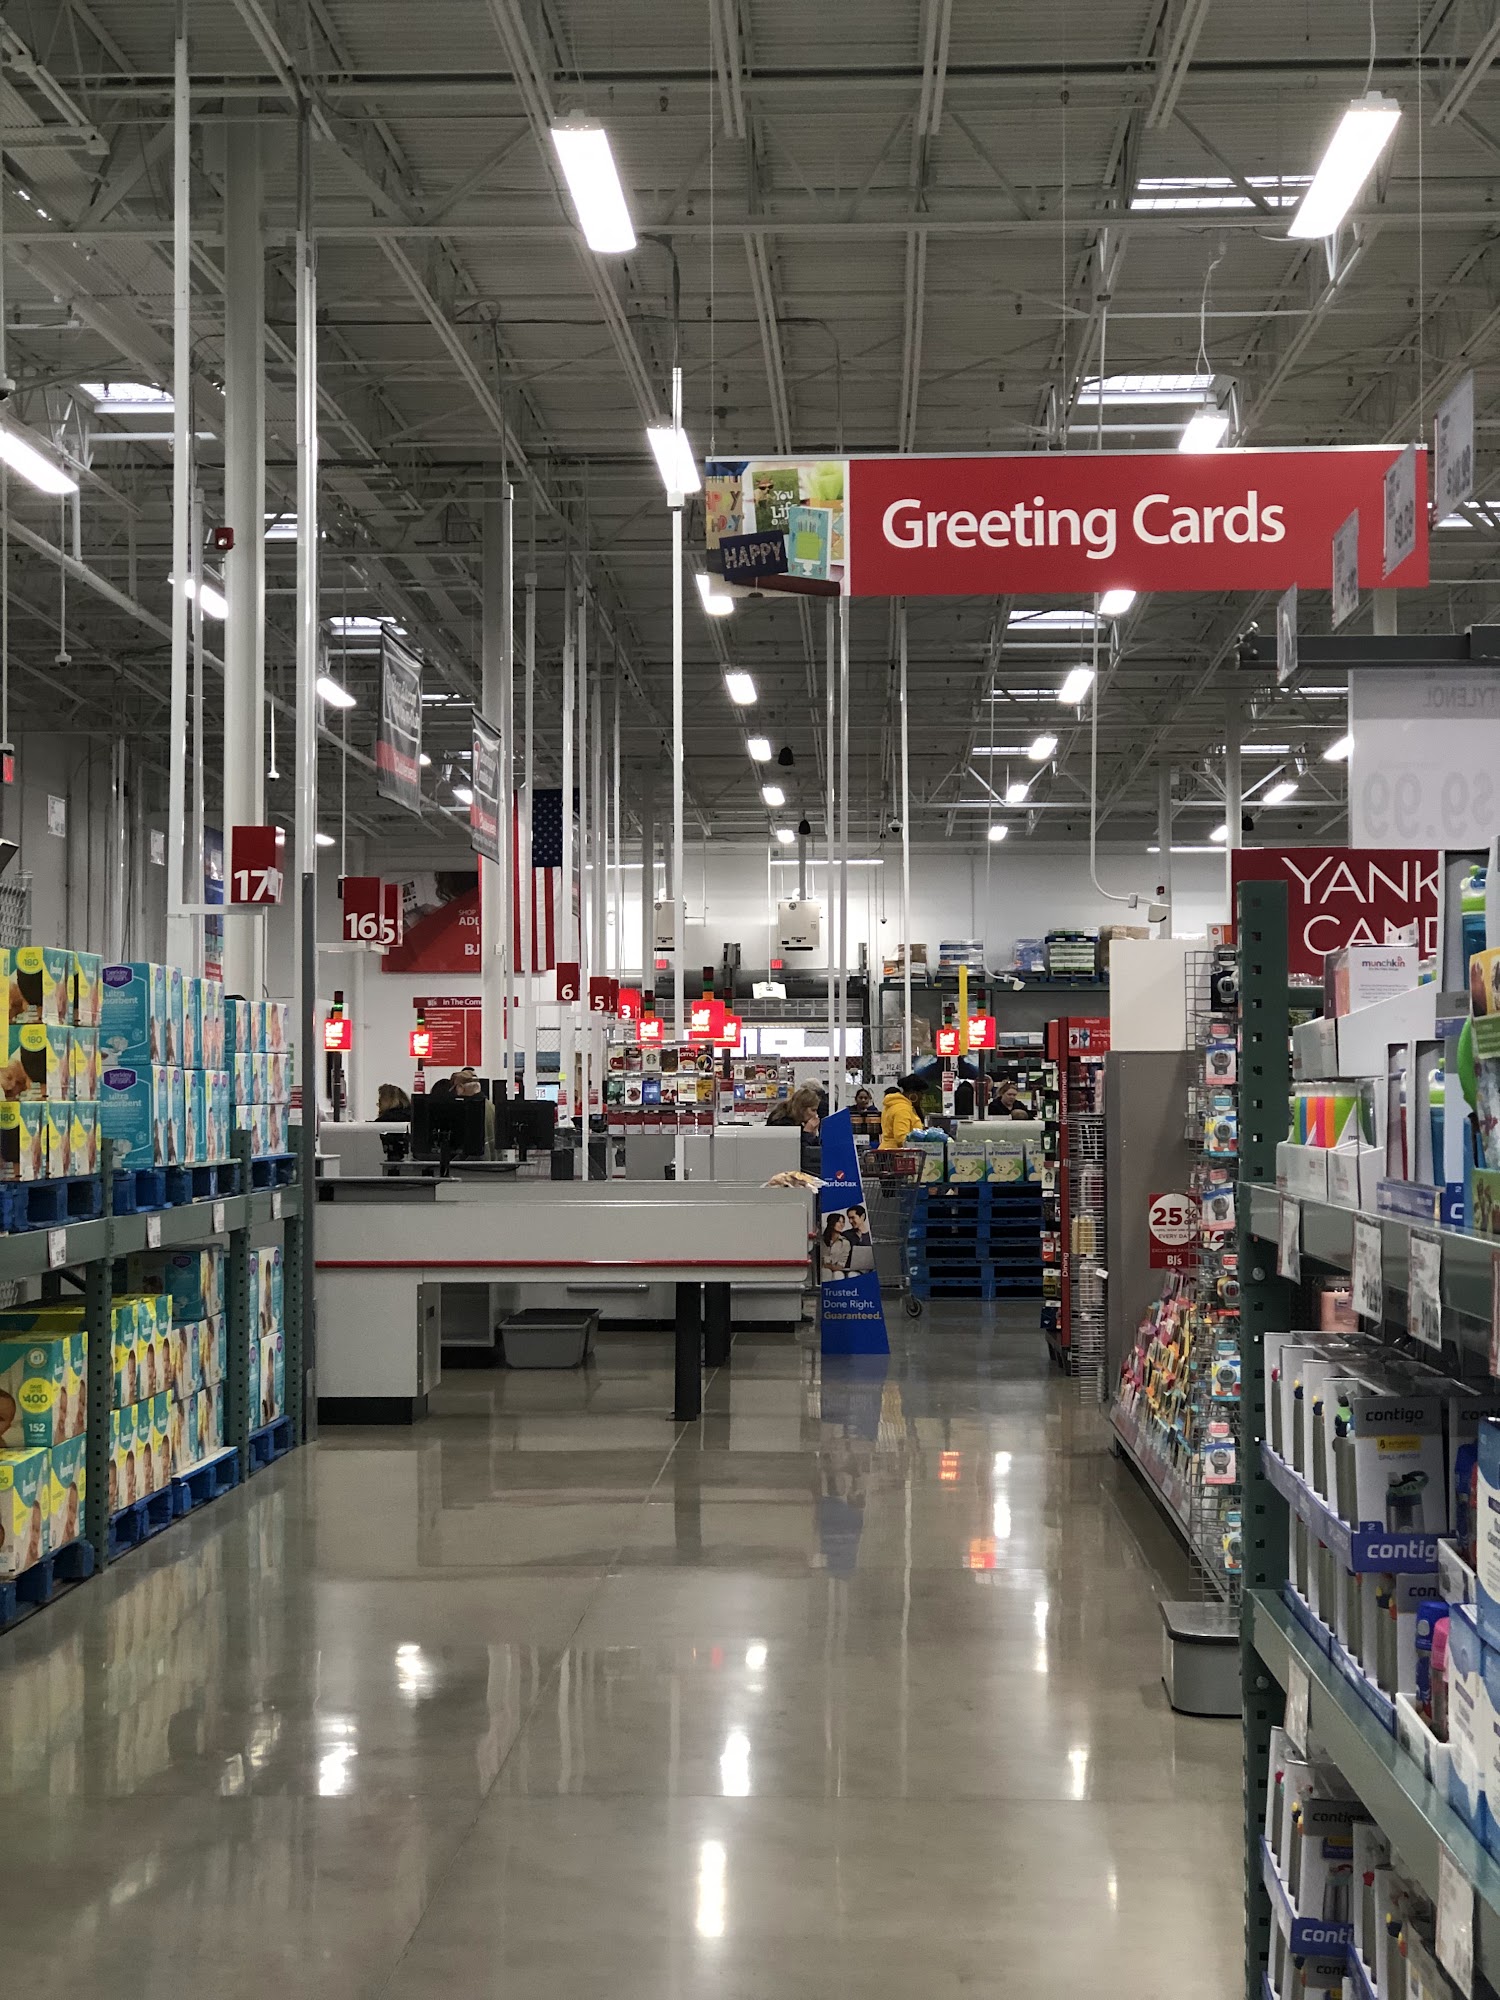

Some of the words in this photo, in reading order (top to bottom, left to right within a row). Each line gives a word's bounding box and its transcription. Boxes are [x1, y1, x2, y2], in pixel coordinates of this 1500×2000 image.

[773, 490, 794, 501] You
[770, 501, 798, 520] Lif
[882, 496, 1118, 559] Greeting
[1132, 491, 1286, 547] Cards
[724, 541, 783, 569] HAPPY
[234, 869, 268, 902] 17
[1281, 856, 1439, 904] YANK
[346, 912, 378, 939] 16
[1361, 955, 1406, 968] munchkin
[561, 983, 574, 1000] 6
[594, 995, 605, 1011] 5
[621, 1004, 632, 1019] 3
[1152, 1207, 1183, 1226] 25
[824, 1288, 859, 1297] Trusted.
[824, 1299, 848, 1309] Done
[849, 1299, 875, 1311] Right.
[824, 1311, 882, 1320] Guaranteed.
[1365, 1408, 1424, 1423] contigo
[29, 1423, 46, 1433] 152
[1367, 1522, 1375, 1530] 2
